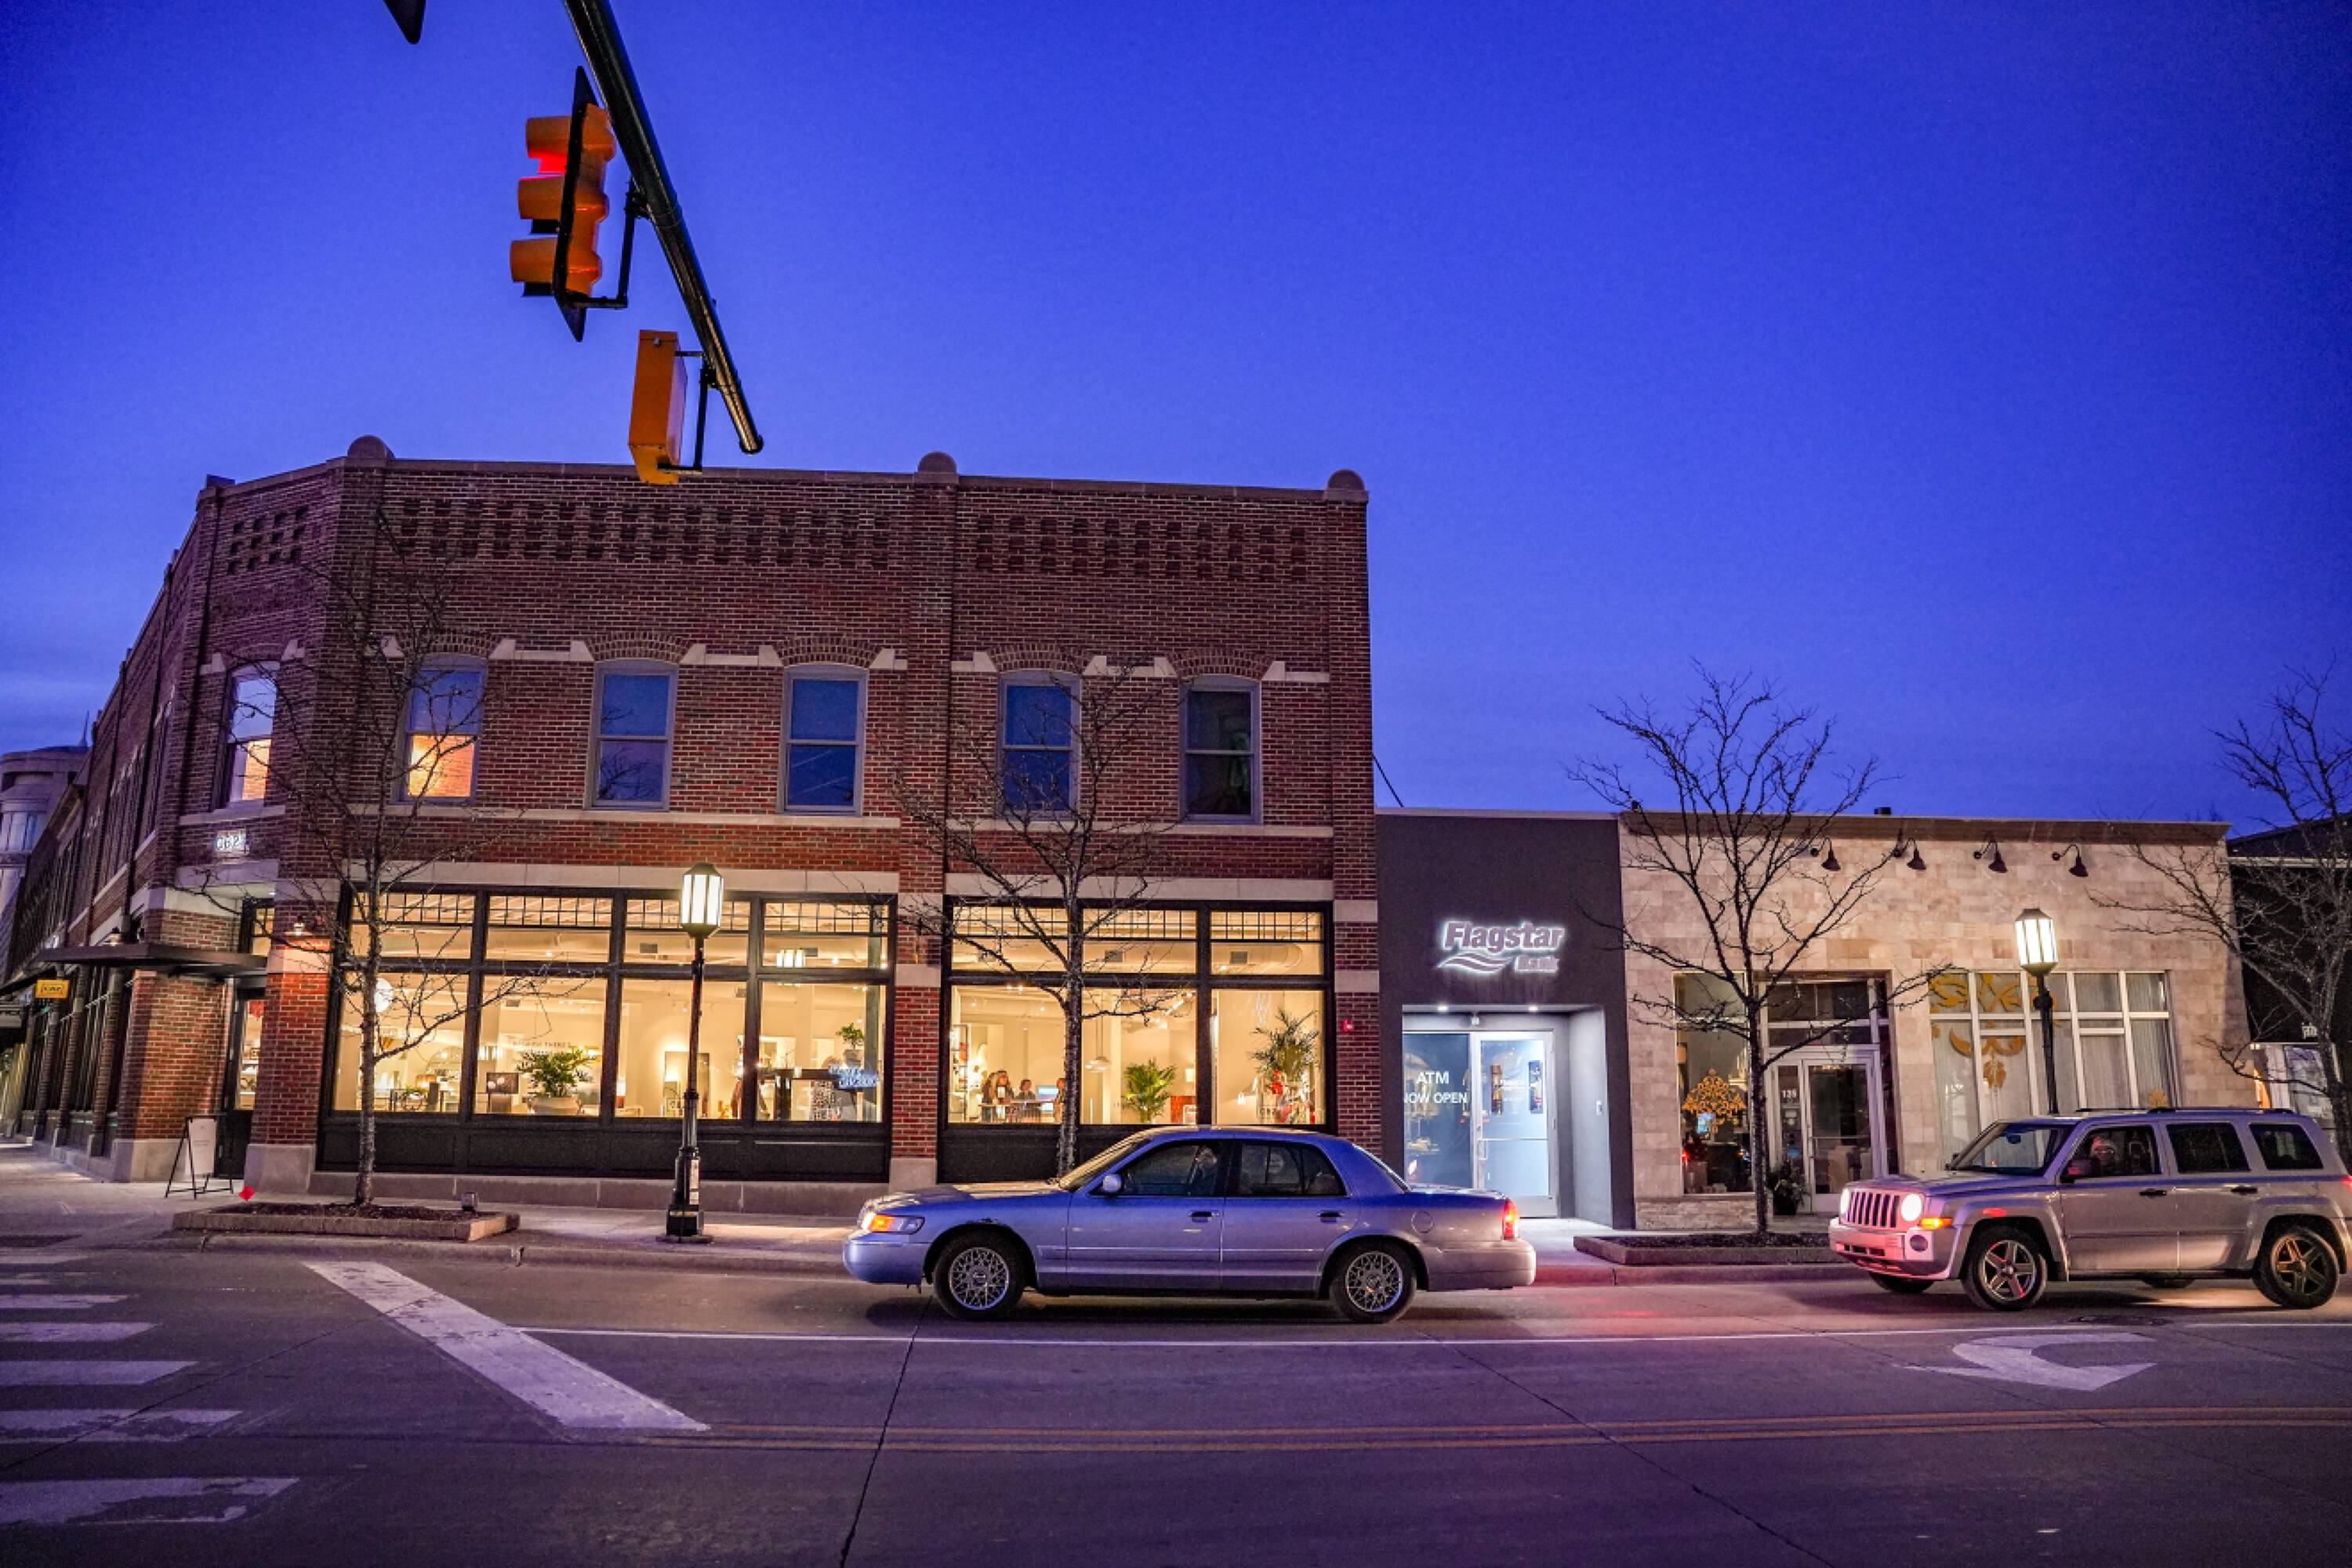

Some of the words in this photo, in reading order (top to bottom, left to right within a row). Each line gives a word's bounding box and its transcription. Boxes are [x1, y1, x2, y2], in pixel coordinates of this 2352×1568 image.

[1443, 920, 1565, 954] Flagstar
[1515, 955, 1559, 974] Bank
[1416, 1071, 1450, 1084] ATM
[1434, 1092, 1468, 1104] OPEN
